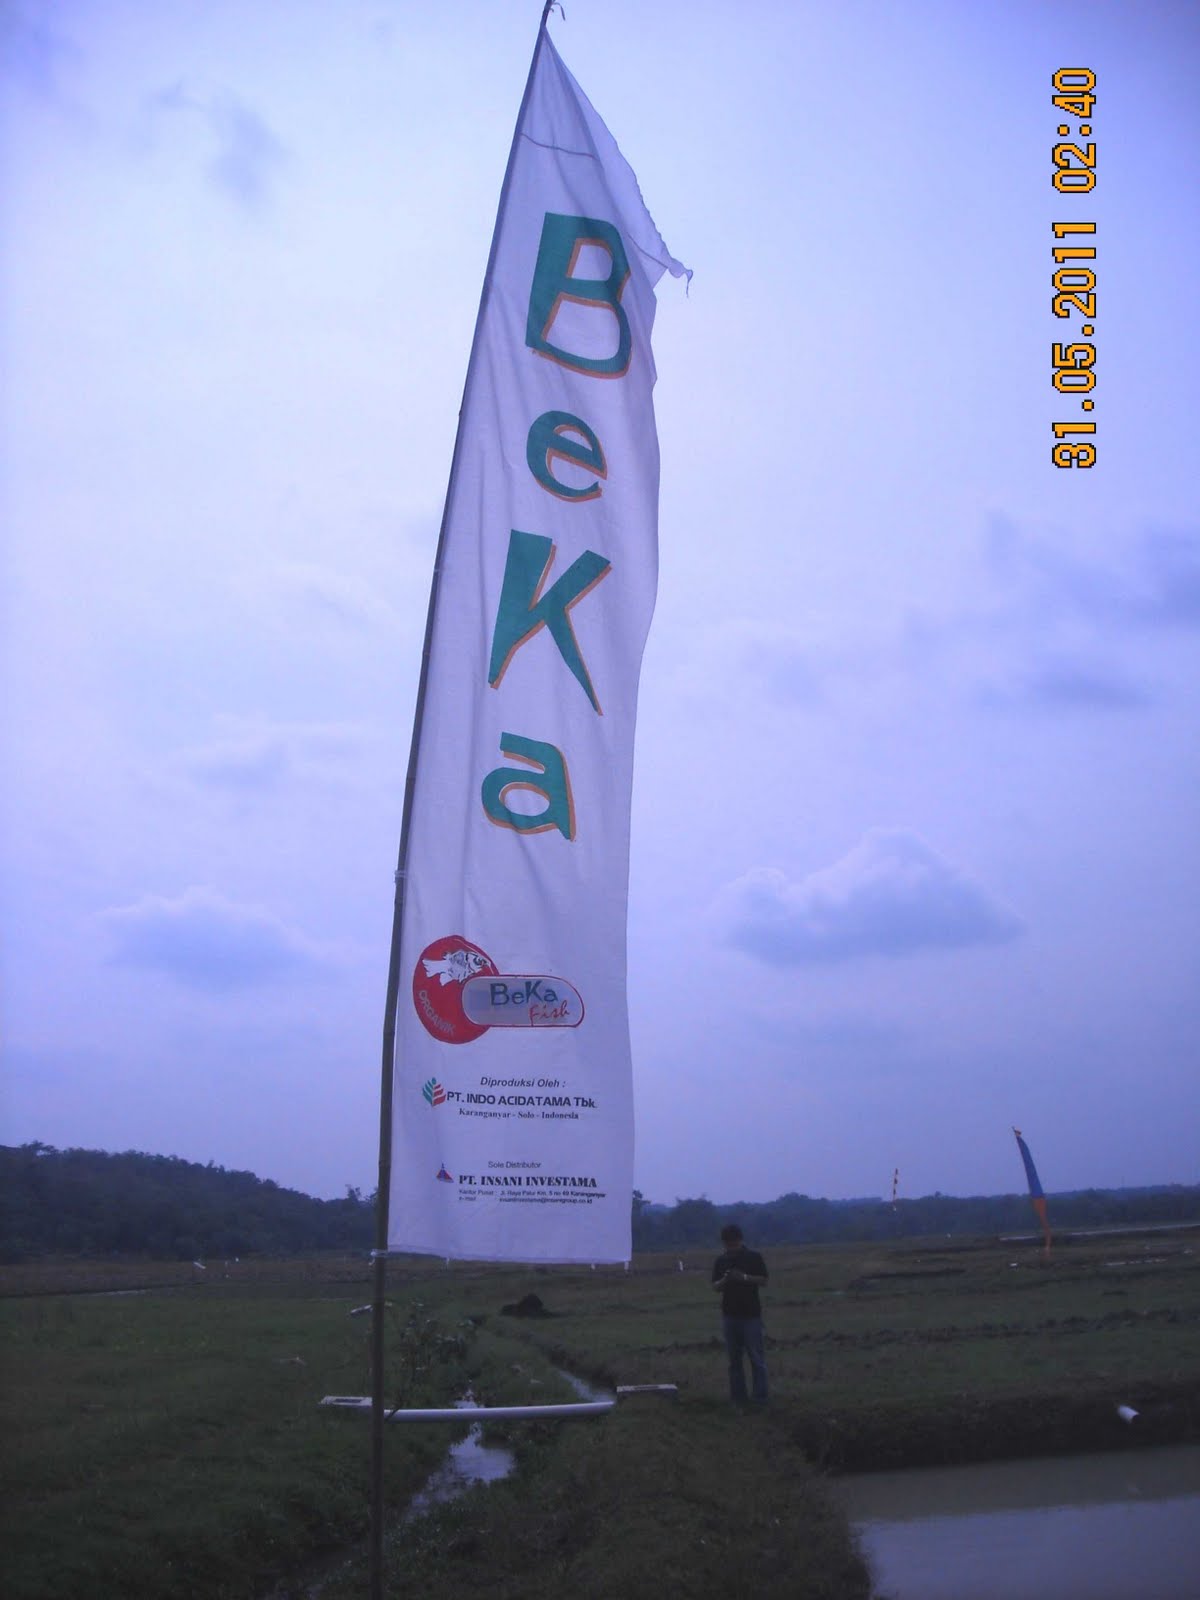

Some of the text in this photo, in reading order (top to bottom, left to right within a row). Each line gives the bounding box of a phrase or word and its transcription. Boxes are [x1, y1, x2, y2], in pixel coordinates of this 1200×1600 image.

[480, 211, 633, 842] BeKa
[489, 979, 559, 1006] BeKa
[418, 989, 457, 1036] ORGANIK
[480, 1076, 535, 1088] Diproduksi
[537, 1078, 560, 1088] Oleh
[447, 1091, 465, 1103] PT.
[466, 1092, 496, 1105] INDO
[498, 1095, 572, 1107] ACIDATAMA
[459, 1108, 511, 1119] Karanganyar
[517, 1111, 535, 1119] Solo
[541, 1111, 580, 1120] Indonesia
[487, 1160, 542, 1169] Sole Distributor
[458, 1175, 598, 1188] PT. INSANI INVESTAMA
